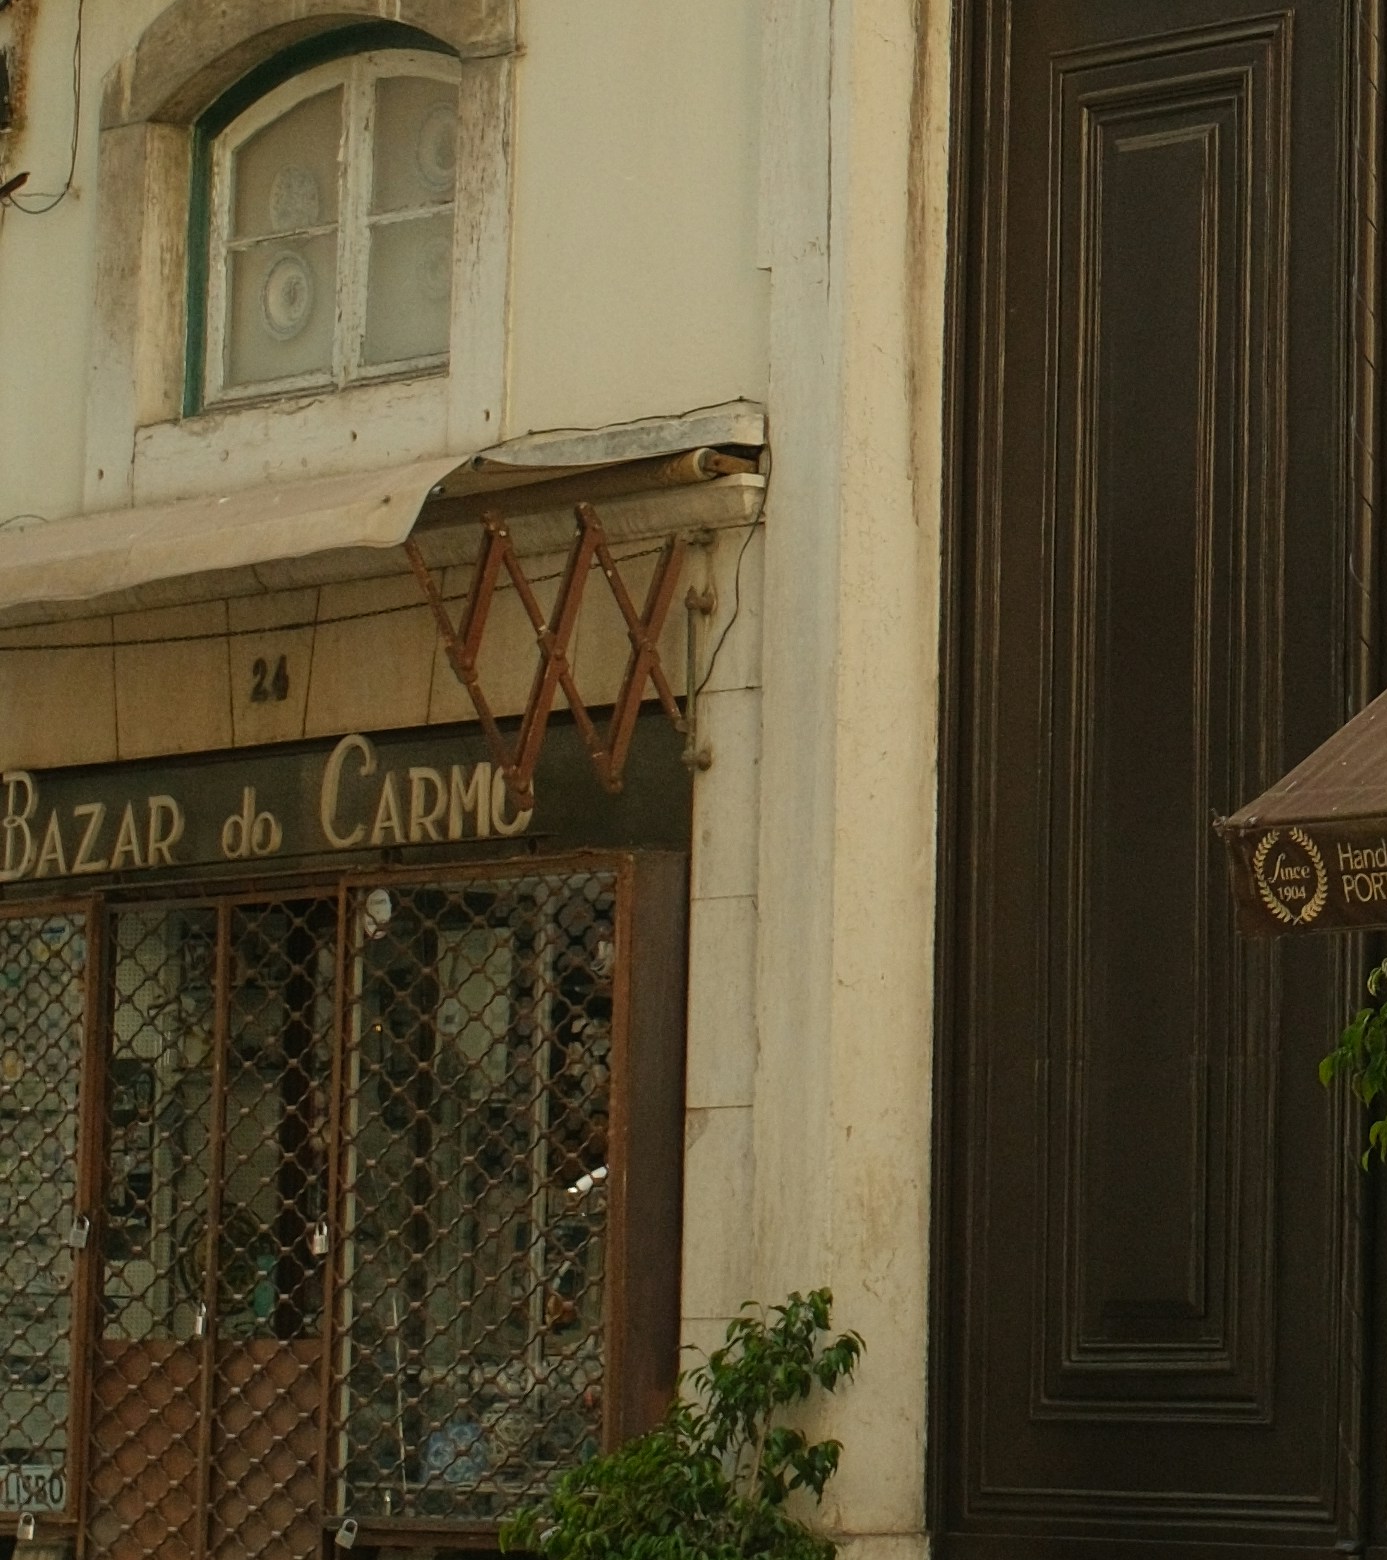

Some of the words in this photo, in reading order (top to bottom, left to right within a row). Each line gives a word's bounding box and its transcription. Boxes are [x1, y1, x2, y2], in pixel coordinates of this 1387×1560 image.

[249, 654, 290, 703] 24
[0, 770, 185, 880] BAZAR
[221, 785, 282, 859] do
[1268, 852, 1312, 884] Since
[1277, 885, 1307, 902] 1904
